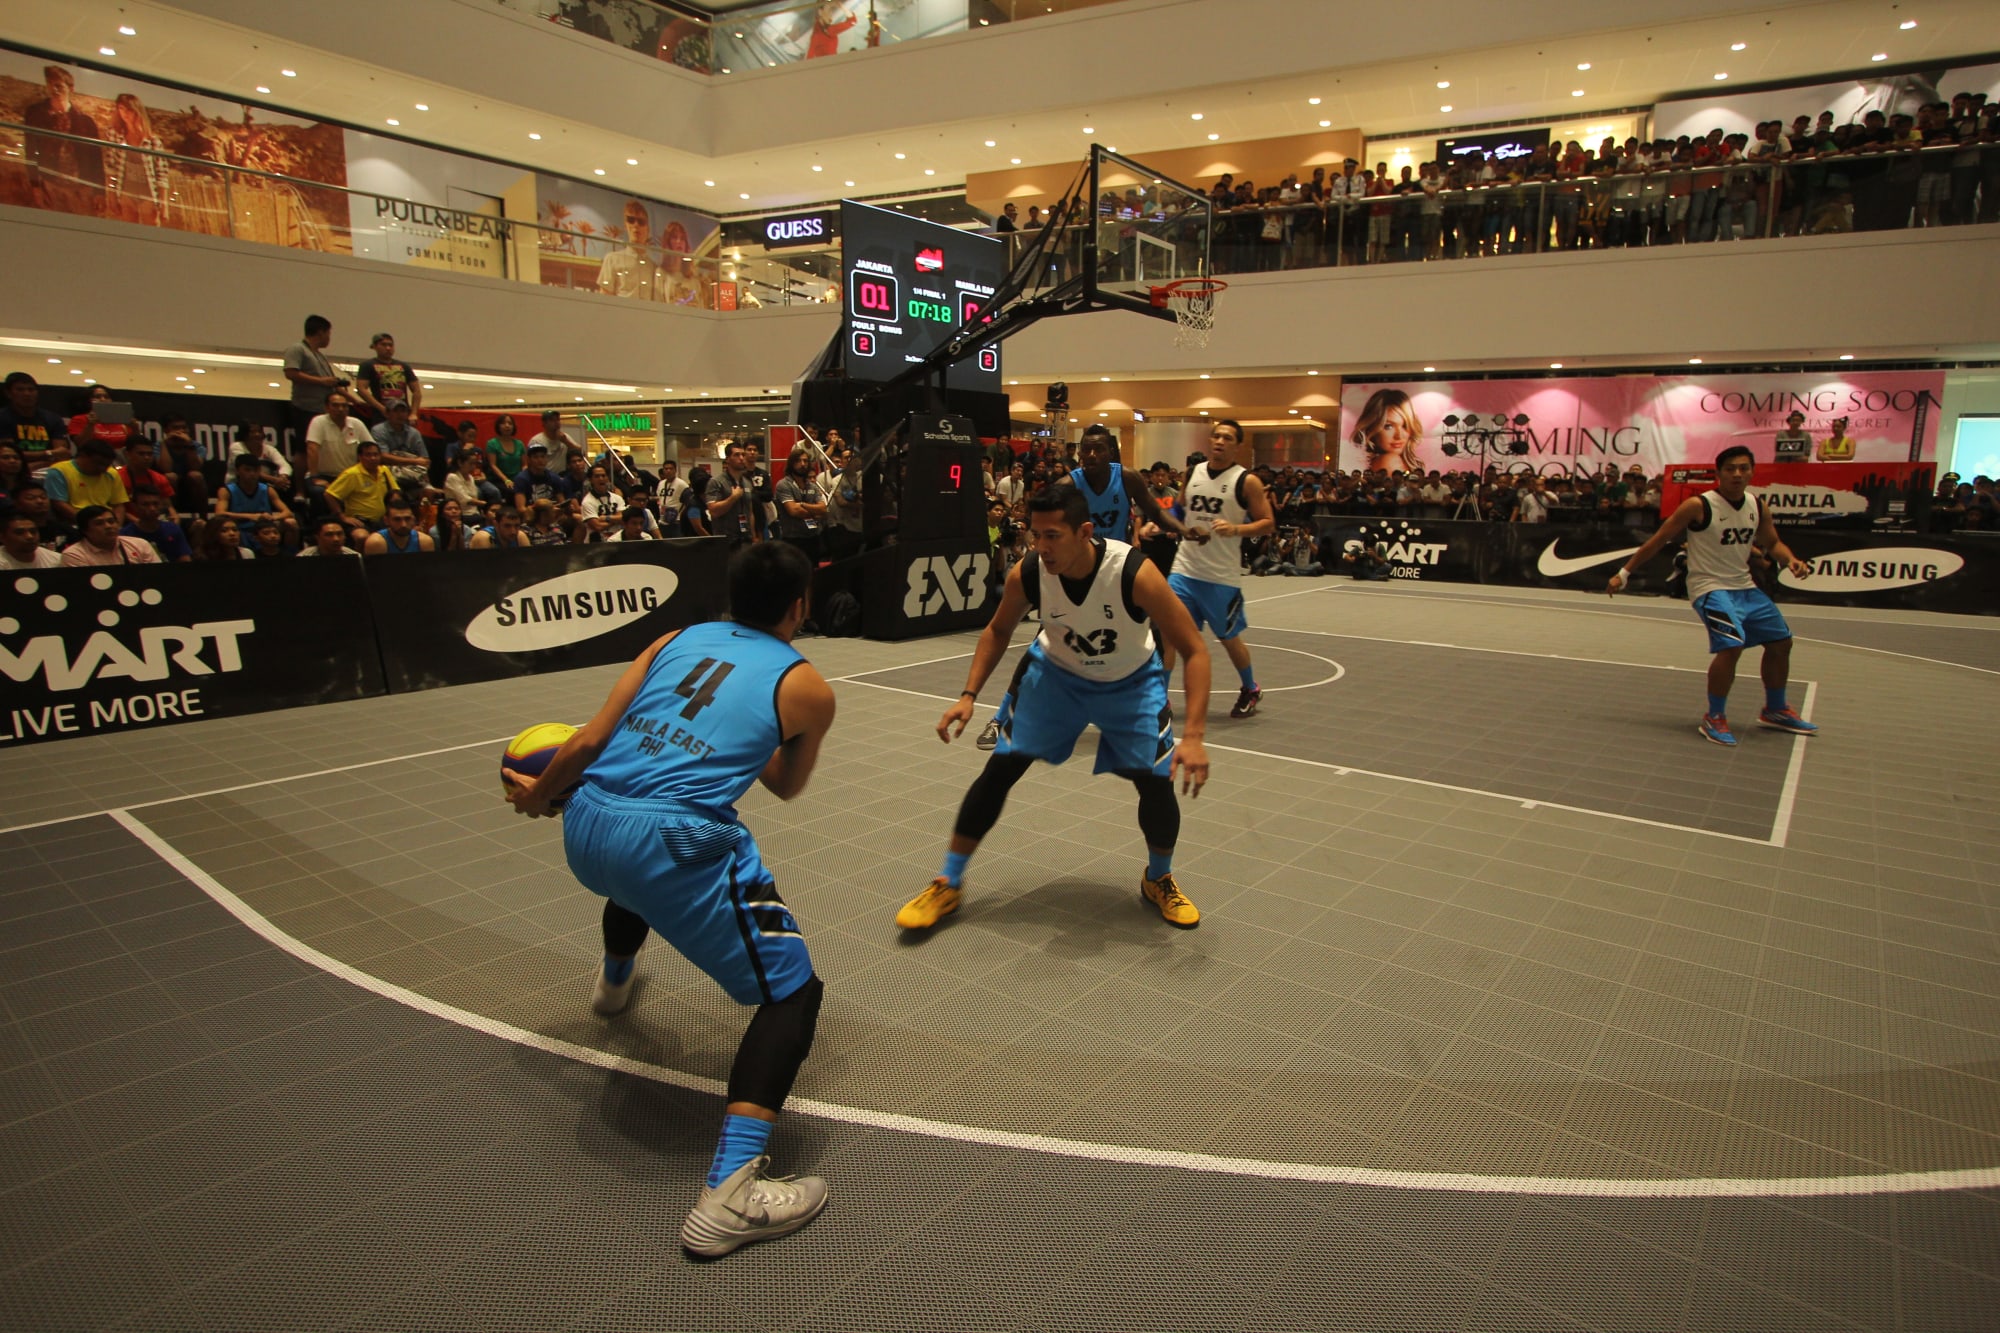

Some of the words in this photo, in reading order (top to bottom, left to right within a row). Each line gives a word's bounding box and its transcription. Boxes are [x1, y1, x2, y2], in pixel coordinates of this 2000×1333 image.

[376, 197, 512, 241] PULL&BEAR
[766, 218, 823, 241] GUESS
[406, 246, 453, 263] COMING
[460, 255, 486, 269] SOON
[856, 259, 893, 275] JAKARTA
[860, 282, 890, 312] 01
[908, 300, 952, 324] 07:18
[851, 320, 876, 332] FOULS
[859, 336, 870, 351] 2
[983, 354, 993, 367] 2
[1700, 391, 1836, 414] COMING
[1753, 416, 1832, 428] VICTRIA'S
[1463, 426, 1641, 456] COMING
[950, 465, 961, 488] 9
[1805, 559, 1939, 581] SAMSUNG
[496, 587, 658, 627] SAMSUNG
[1104, 604, 1114, 619] 5
[0, 619, 256, 691] MART
[673, 657, 736, 721] 4
[90, 688, 204, 728] MORE
[637, 736, 667, 757] PHI
[669, 727, 717, 761] EAST
